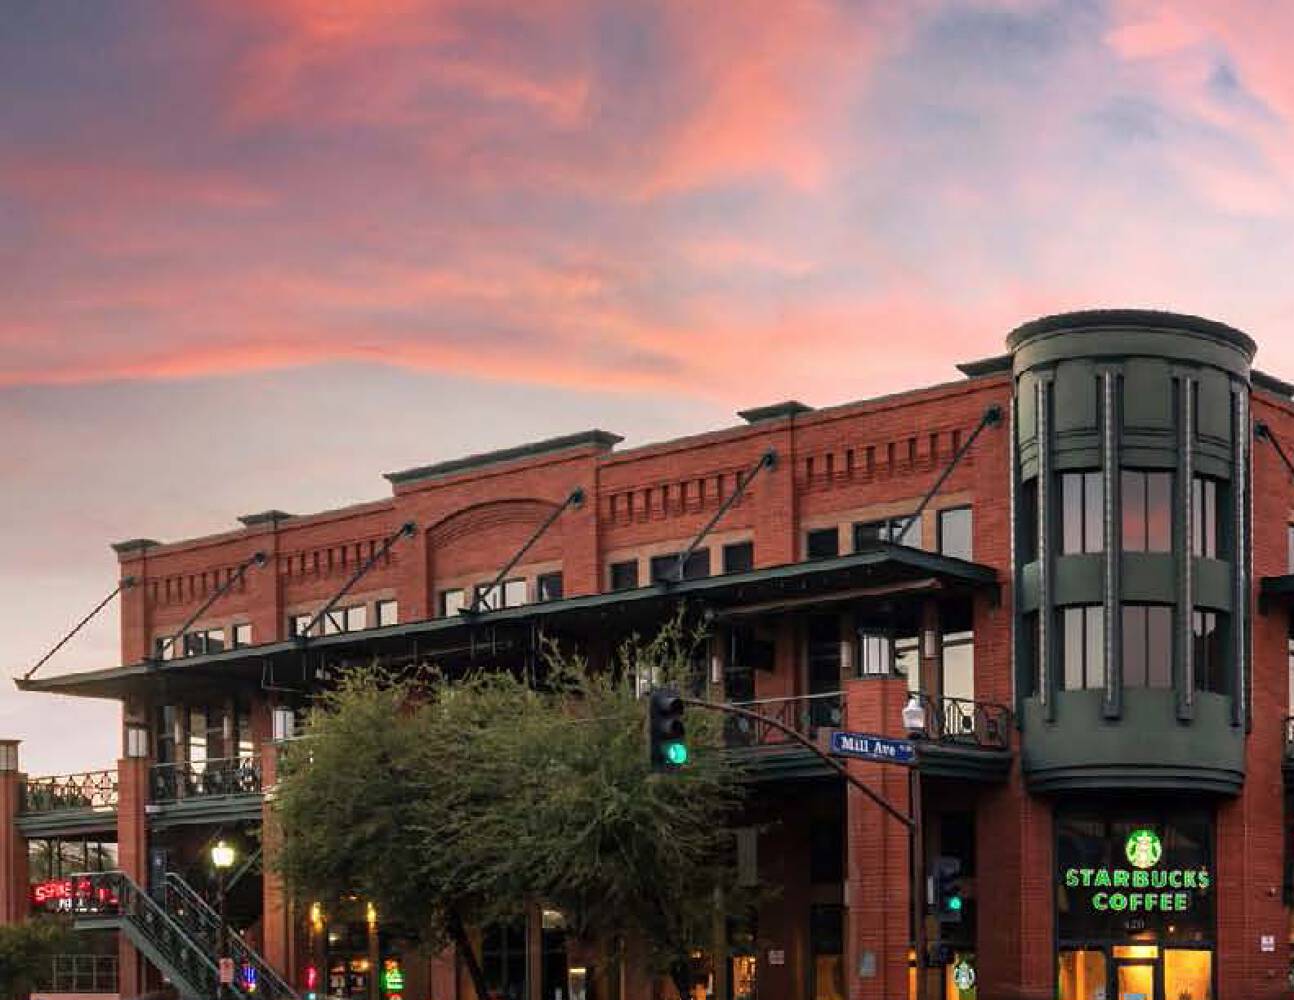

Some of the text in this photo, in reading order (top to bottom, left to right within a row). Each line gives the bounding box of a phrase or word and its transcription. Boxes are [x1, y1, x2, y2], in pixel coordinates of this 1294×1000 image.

[841, 736, 868, 753] Mill
[873, 741, 896, 756] Ave
[1066, 868, 1209, 888] STARBUCKS
[1092, 892, 1188, 911] COFFEE
